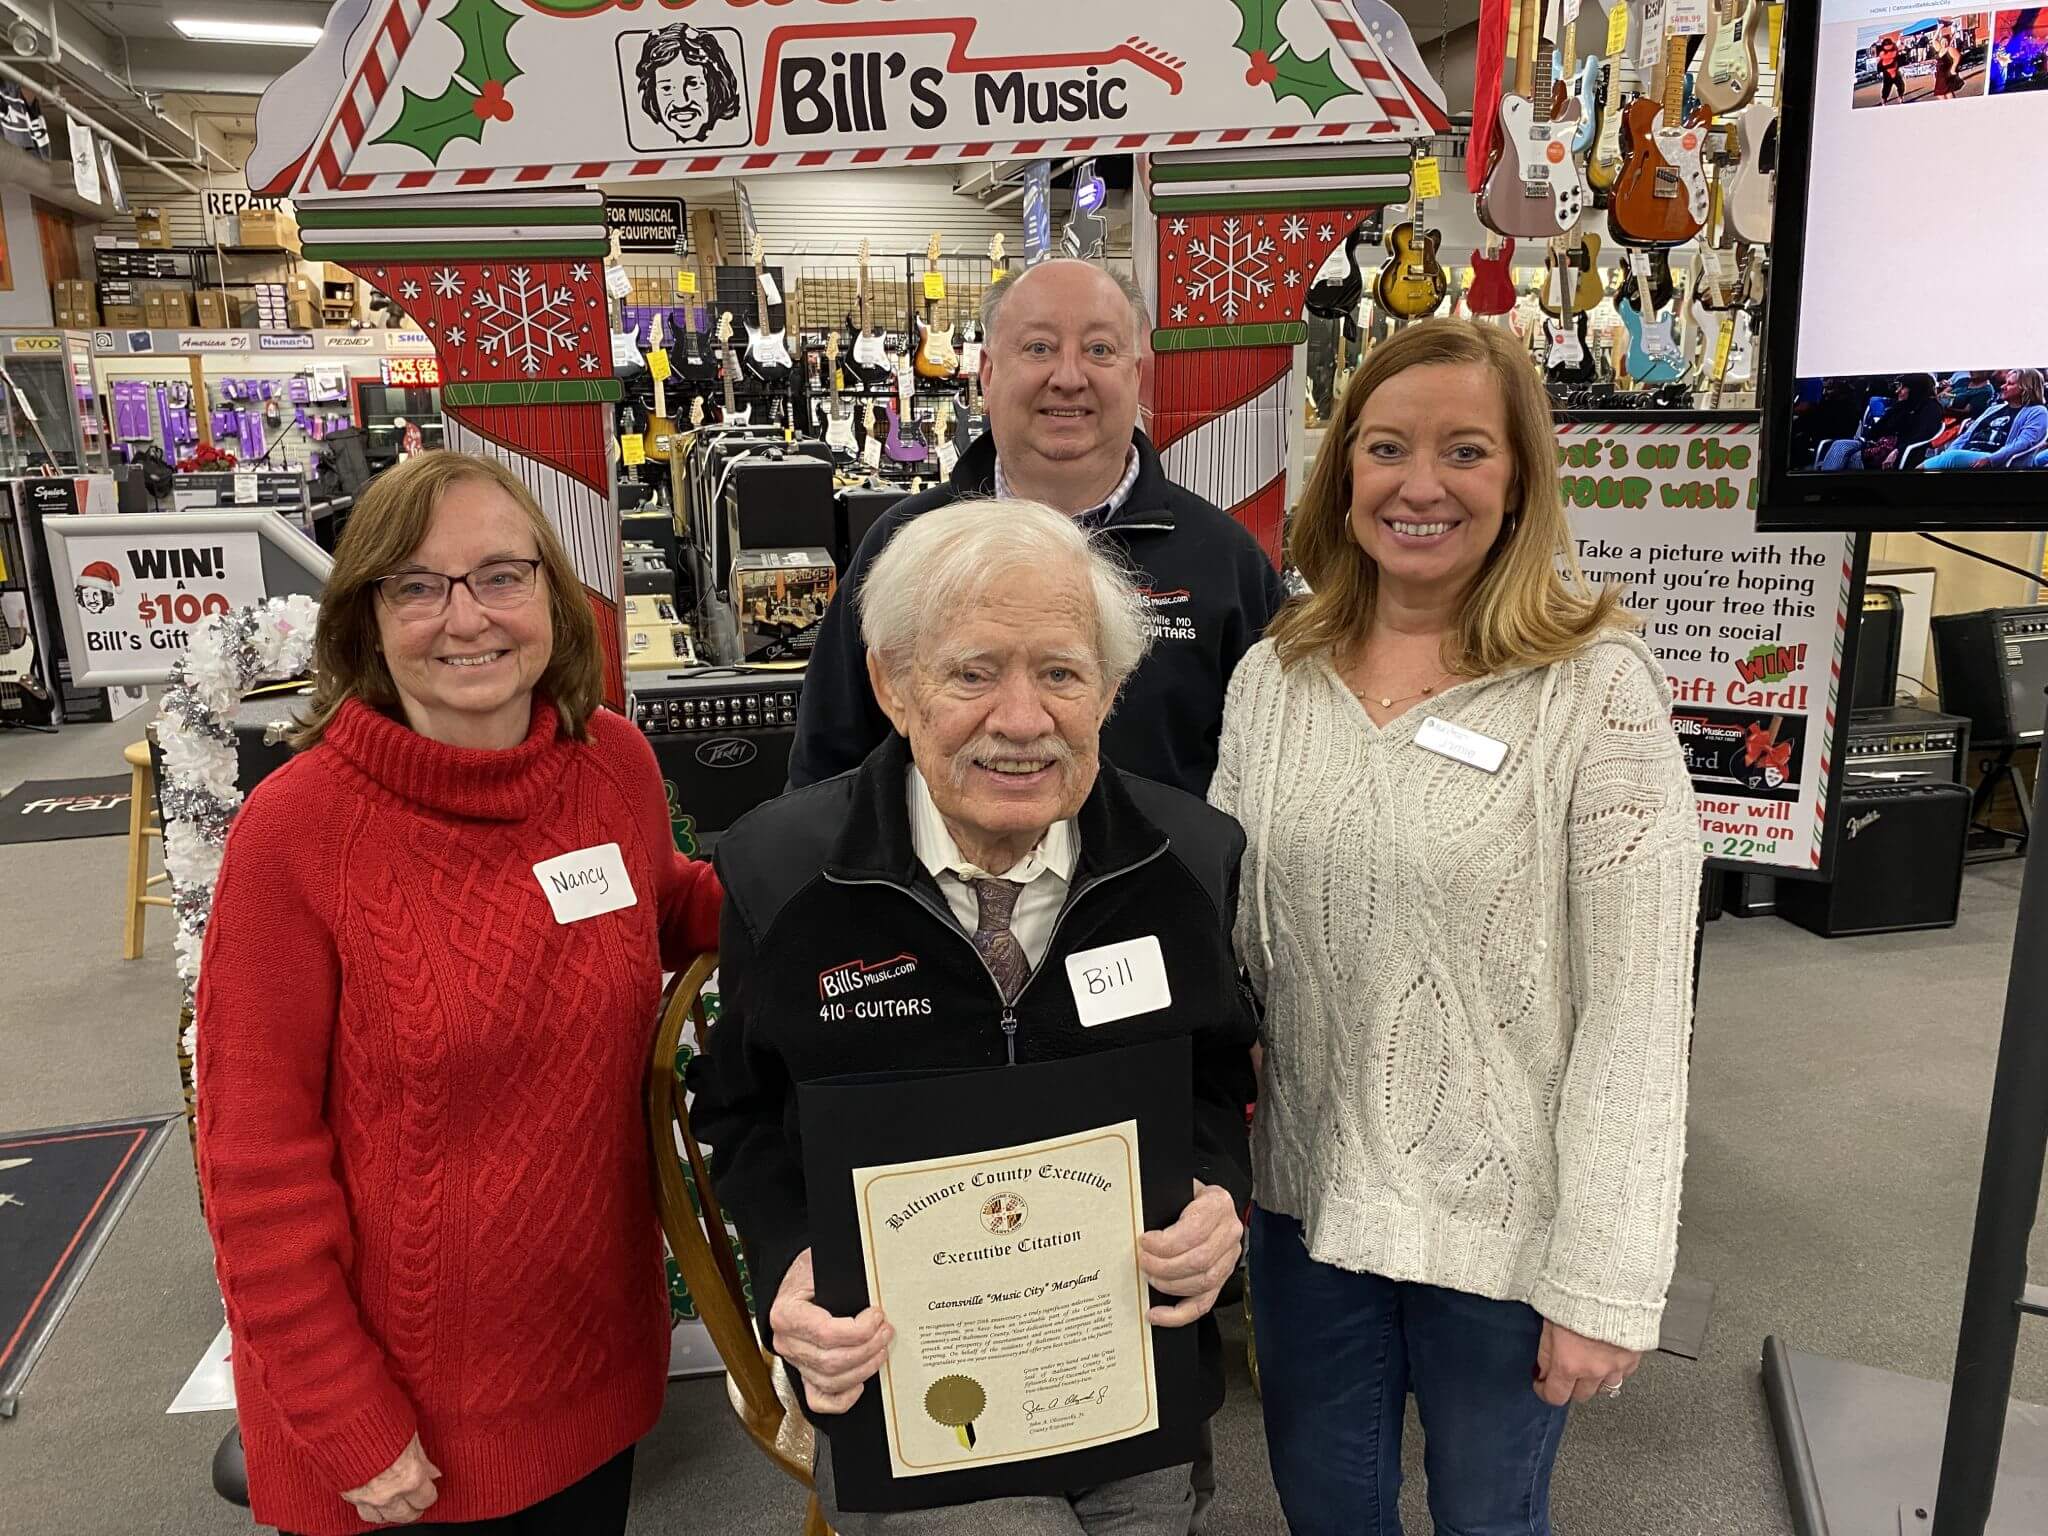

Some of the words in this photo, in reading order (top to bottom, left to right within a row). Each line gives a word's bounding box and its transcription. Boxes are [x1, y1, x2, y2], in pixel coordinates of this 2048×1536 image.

[780, 50, 948, 134] Bill's
[974, 66, 1128, 125] Music
[207, 193, 283, 214] REPAIR
[606, 208, 626, 222] FOR
[628, 208, 674, 223] MUSICAL
[620, 226, 678, 240] EQUIPMENT
[181, 336, 226, 347] American
[230, 336, 248, 349] DJ
[262, 336, 310, 346] Numark
[389, 359, 415, 371] MORE
[417, 359, 438, 371] GEA
[391, 371, 418, 384] BACK
[420, 371, 439, 384] HER
[1636, 444, 1680, 470] on
[1687, 437, 1752, 470] the
[1660, 476, 1740, 510] wish
[126, 546, 226, 580] WIN!
[1575, 539, 1624, 559] Take
[1630, 547, 1642, 559] a
[1649, 544, 1724, 564] picture
[1731, 544, 1781, 565] with
[1789, 545, 1826, 567] the
[176, 580, 186, 590] A
[1663, 569, 1730, 591] you're
[1737, 569, 1815, 597] hoping
[138, 592, 230, 629] $100
[1666, 597, 1720, 616] your
[1722, 596, 1765, 615] tree
[1772, 596, 1815, 618] this
[1141, 624, 1196, 640] GUITARS
[1176, 617, 1192, 627] MD
[1655, 622, 1678, 636] us
[1686, 623, 1711, 638] on
[1718, 623, 1782, 642] social
[87, 631, 142, 651] Bill's
[150, 629, 189, 650] Gift
[1650, 646, 1701, 662] ance
[1709, 645, 1730, 664] to
[1735, 643, 1808, 685] WIN!
[1669, 676, 1716, 705] Gift
[1726, 680, 1809, 710] Card!
[1702, 726, 1742, 738] Music.com
[1686, 751, 1719, 769] ard
[1747, 803, 1791, 820] will
[1766, 826, 1794, 841] on
[1723, 837, 1777, 858] 22nd
[551, 863, 609, 896] Nancy
[863, 962, 916, 986] Music.com
[1083, 957, 1134, 995] Bill
[819, 998, 932, 1021] 410-GUITARS
[885, 1181, 966, 1232] Baltimore
[971, 1167, 1032, 1187] County
[1038, 1164, 1112, 1192] Executive
[933, 1244, 1011, 1265] Executive
[1017, 1230, 1081, 1252] Citation
[928, 1294, 983, 1311] Catonsville
[1051, 1269, 1101, 1292] Maryland
